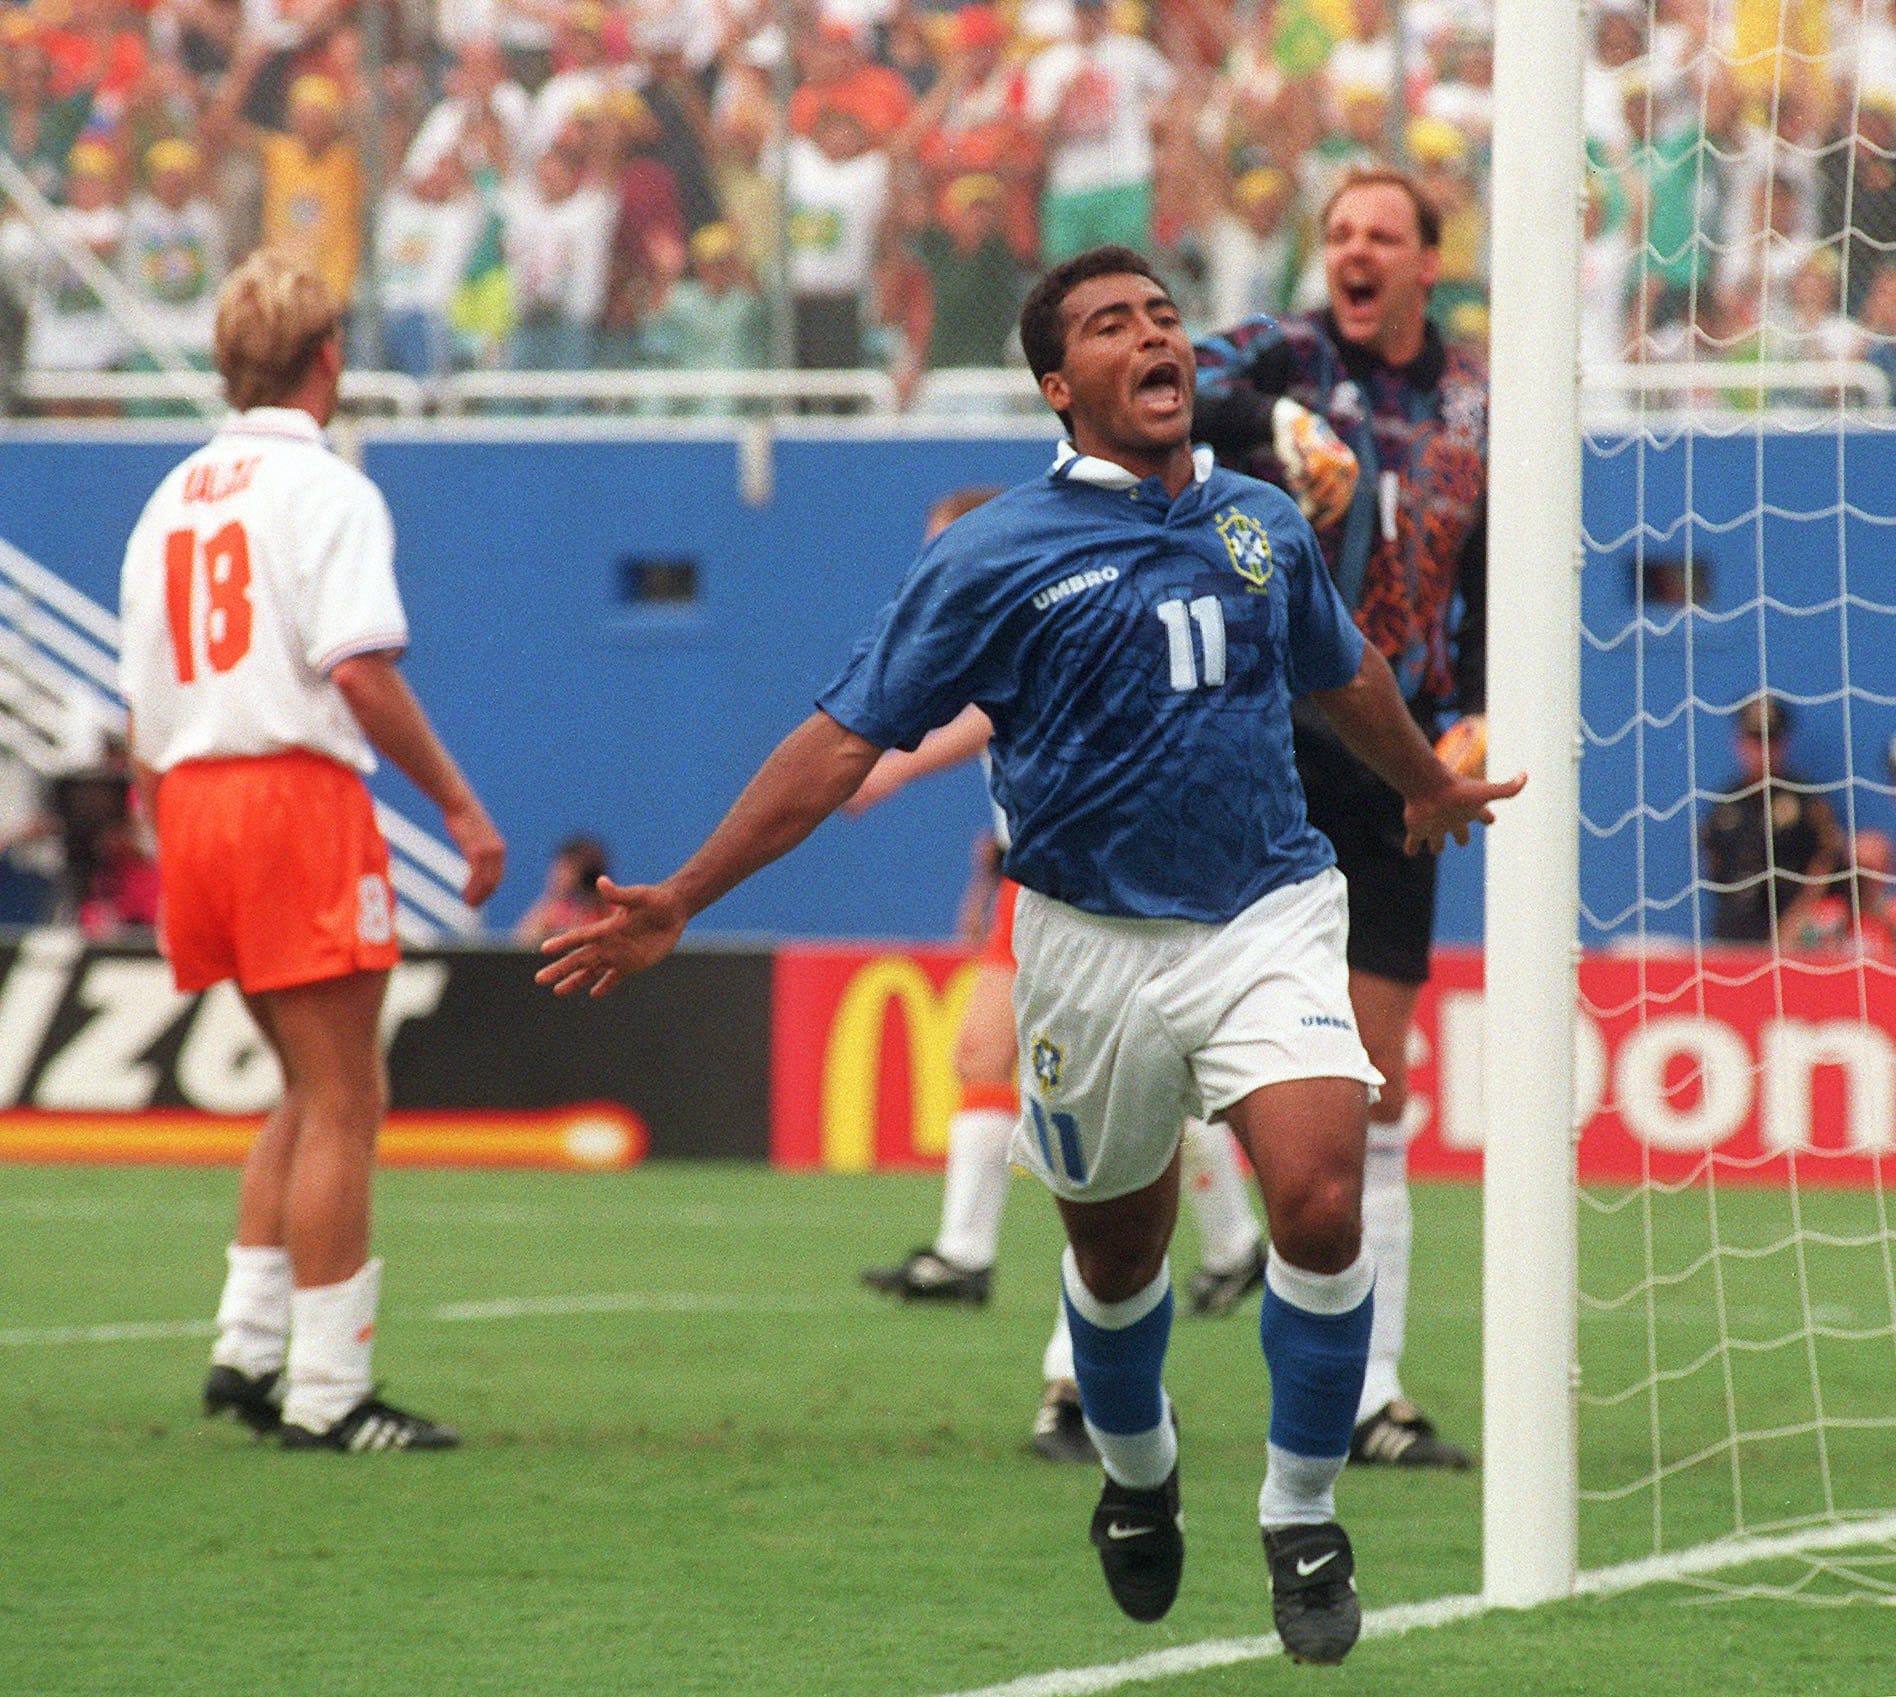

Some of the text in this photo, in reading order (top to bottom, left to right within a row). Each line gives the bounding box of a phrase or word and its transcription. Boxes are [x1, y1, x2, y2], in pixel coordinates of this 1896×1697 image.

[164, 519, 252, 684] 18
[1033, 565, 1119, 611] UMBRO
[1157, 595, 1226, 690] 11
[1030, 1097, 1088, 1184] 11
